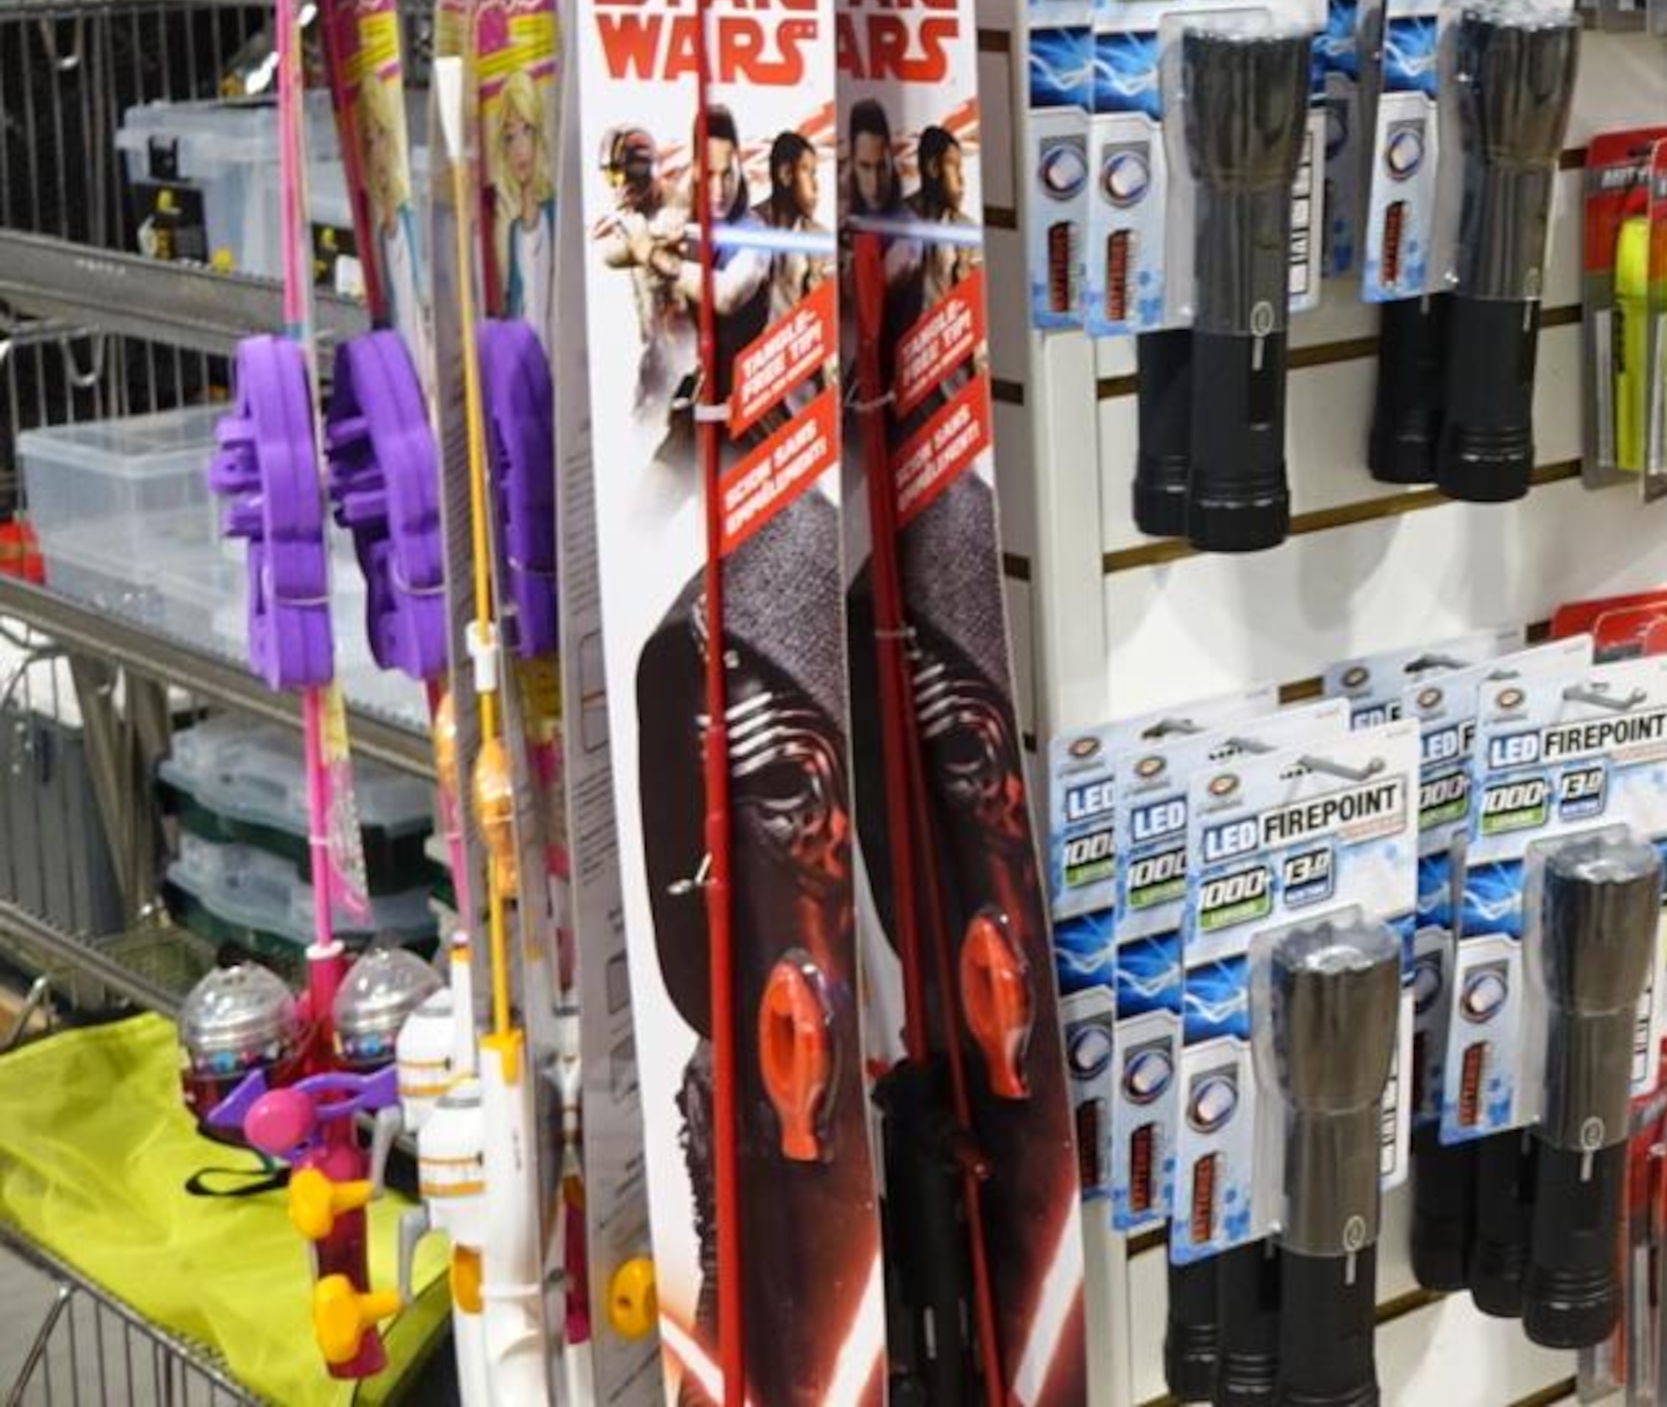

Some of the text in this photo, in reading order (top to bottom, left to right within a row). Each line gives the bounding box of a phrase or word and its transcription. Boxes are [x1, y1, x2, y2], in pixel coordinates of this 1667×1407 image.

[595, 13, 819, 86] WARS
[836, 13, 959, 84] ARS
[1421, 729, 1458, 762] LED
[1492, 712, 1667, 767] LED FIREPOINT
[1134, 800, 1187, 842] LED
[1204, 784, 1399, 862] LED FIREPOINT
